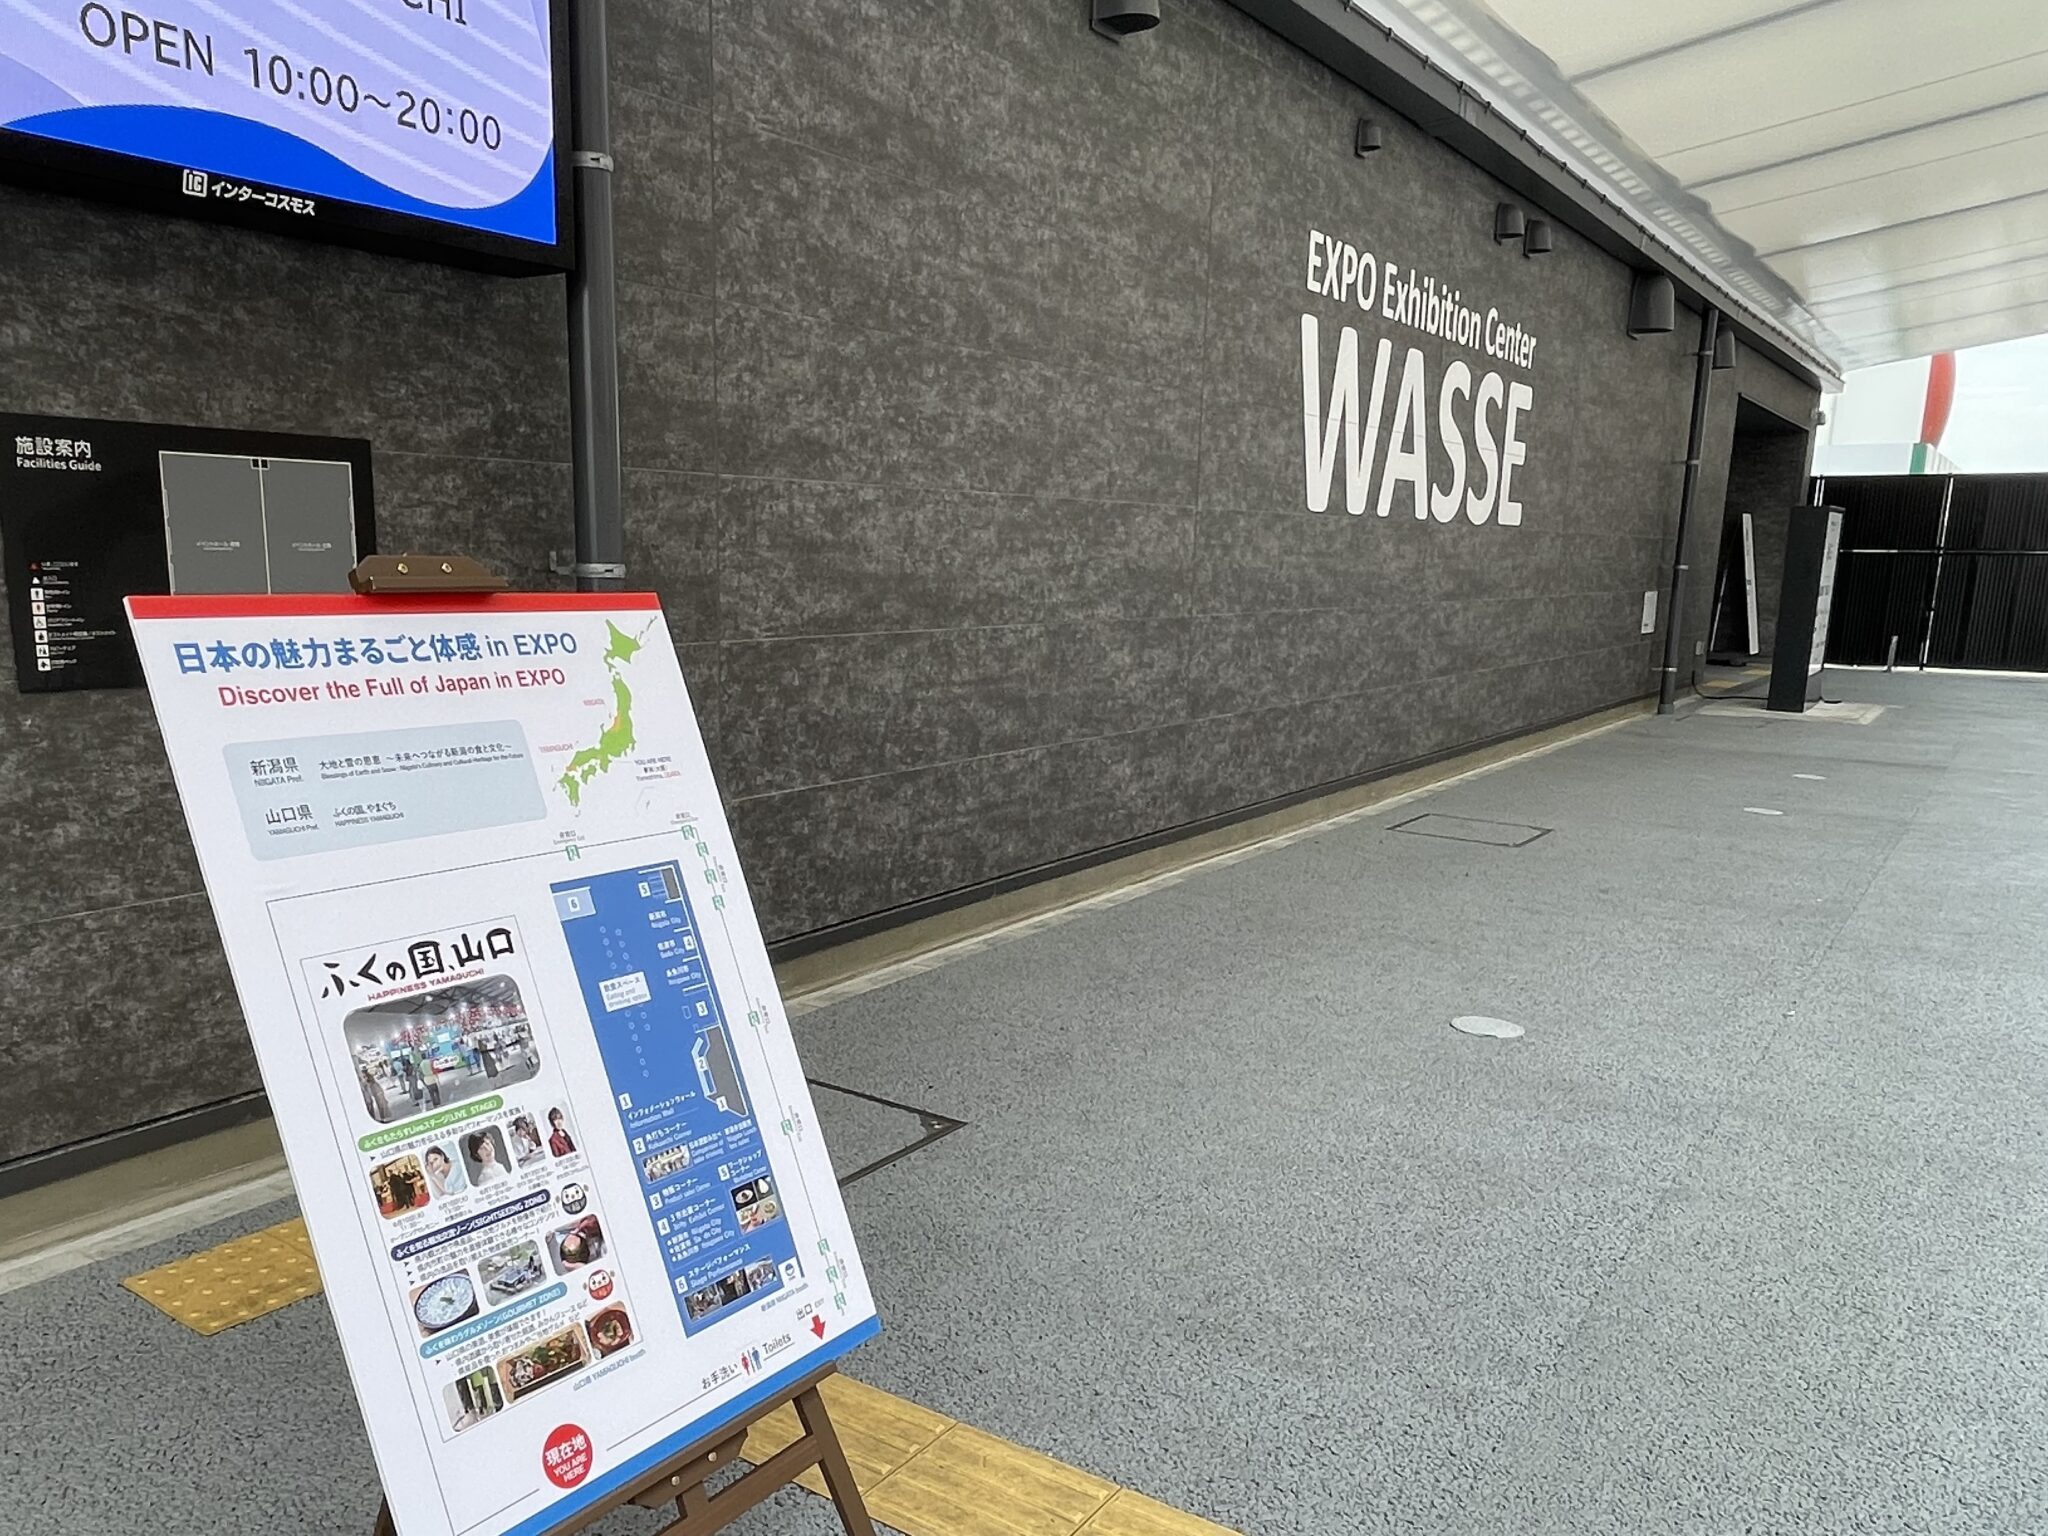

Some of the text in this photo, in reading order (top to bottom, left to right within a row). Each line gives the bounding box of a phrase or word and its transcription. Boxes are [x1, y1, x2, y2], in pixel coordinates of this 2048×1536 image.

[80, 2, 214, 76] OPEN
[211, 181, 315, 216] インターコスモス
[1306, 229, 1537, 369] EXPO Exhibition Center
[1301, 313, 1533, 526] WASSE
[15, 436, 92, 458] 施設案内
[16, 456, 102, 471] Facilities Guide
[173, 632, 577, 674] 日本の魅力まるごと体感 in EXPO
[218, 668, 566, 706] Discover the Full of Japan in EXPO
[250, 757, 299, 776] 新潟県
[265, 804, 314, 825] 山口県
[367, 968, 485, 1001] HAPPINESS YAMAGUCHI
[762, 1333, 791, 1355] Toilets
[545, 1433, 588, 1467] 現在地
[553, 1452, 588, 1478] YOU ARE
[563, 1463, 587, 1482] HERE
